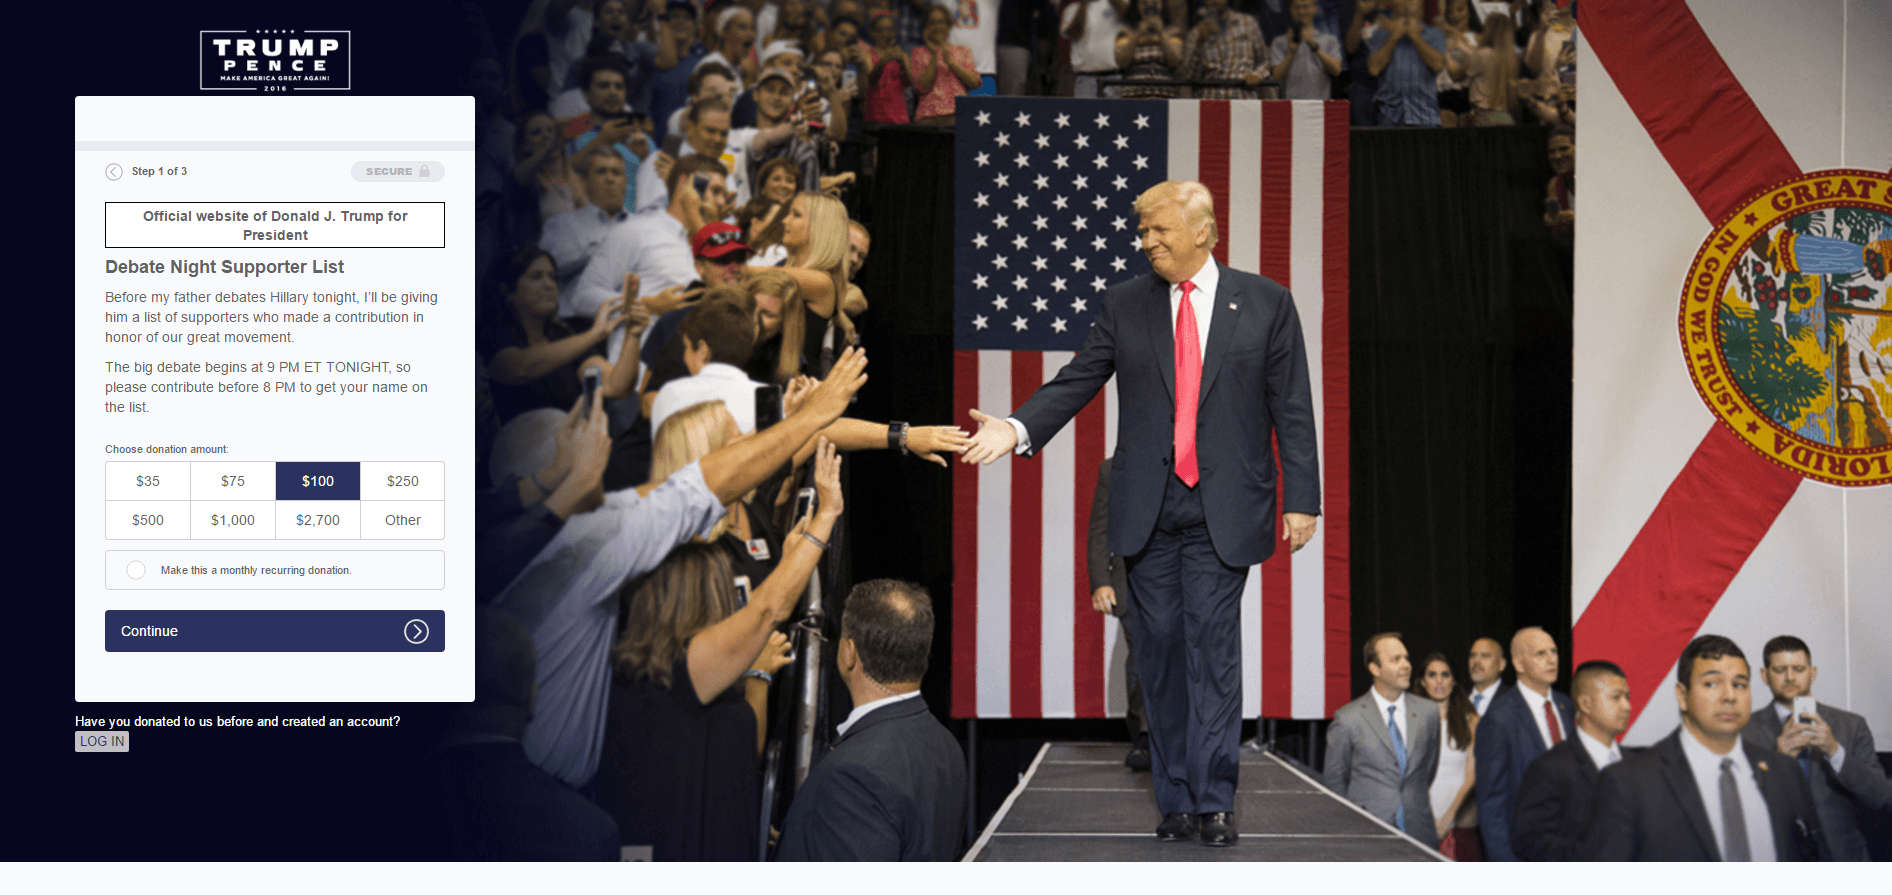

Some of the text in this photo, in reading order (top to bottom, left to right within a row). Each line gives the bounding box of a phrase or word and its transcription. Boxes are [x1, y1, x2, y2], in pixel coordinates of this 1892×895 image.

[1771, 178, 1878, 212] GREAT
[1690, 228, 1744, 417] IN GOD WE TRUST
[1773, 431, 1892, 478] LORIDA
